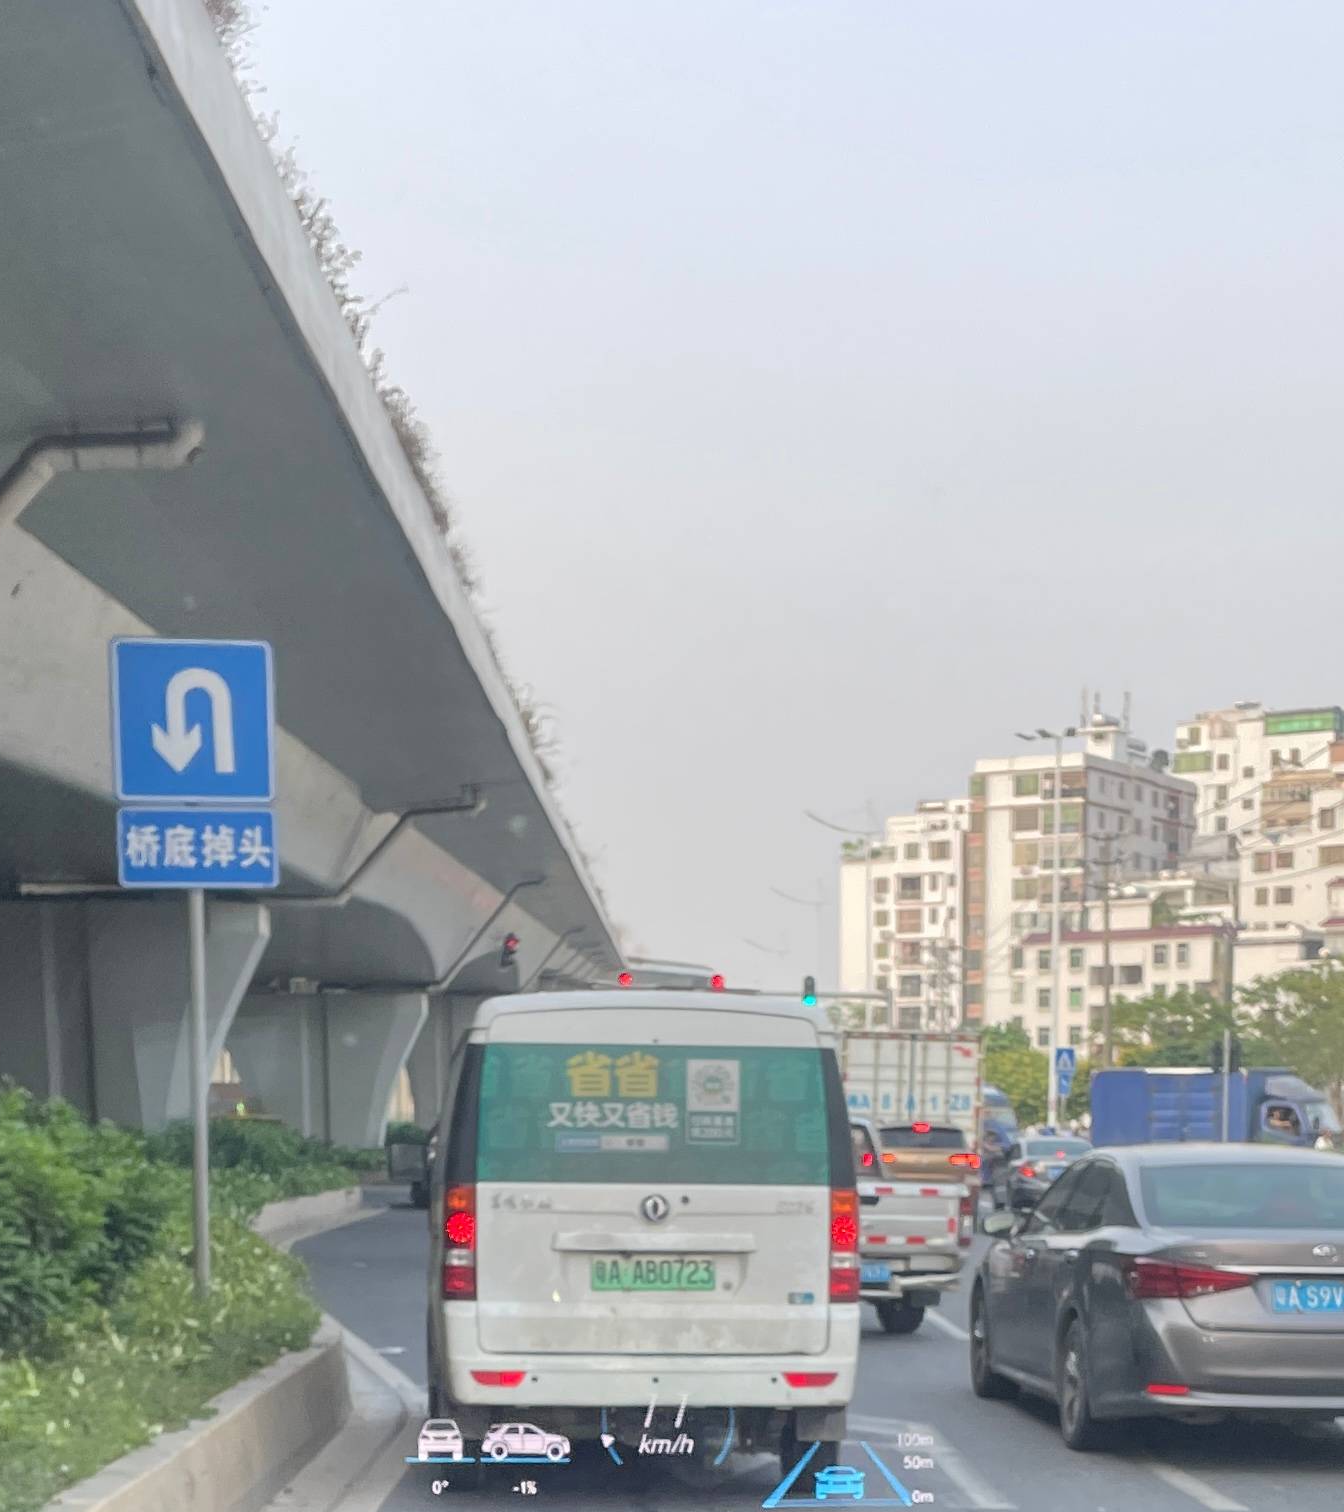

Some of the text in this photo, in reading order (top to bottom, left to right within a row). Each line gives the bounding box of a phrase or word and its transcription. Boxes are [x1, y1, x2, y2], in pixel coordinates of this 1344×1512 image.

[125, 824, 272, 869] 桥底掉头
[565, 1051, 659, 1098] 省省
[546, 1101, 679, 1129] 又快又省钱
[638, 1433, 695, 1454] km/h
[903, 1455, 934, 1469] 50m
[912, 1490, 934, 1504] 0m
